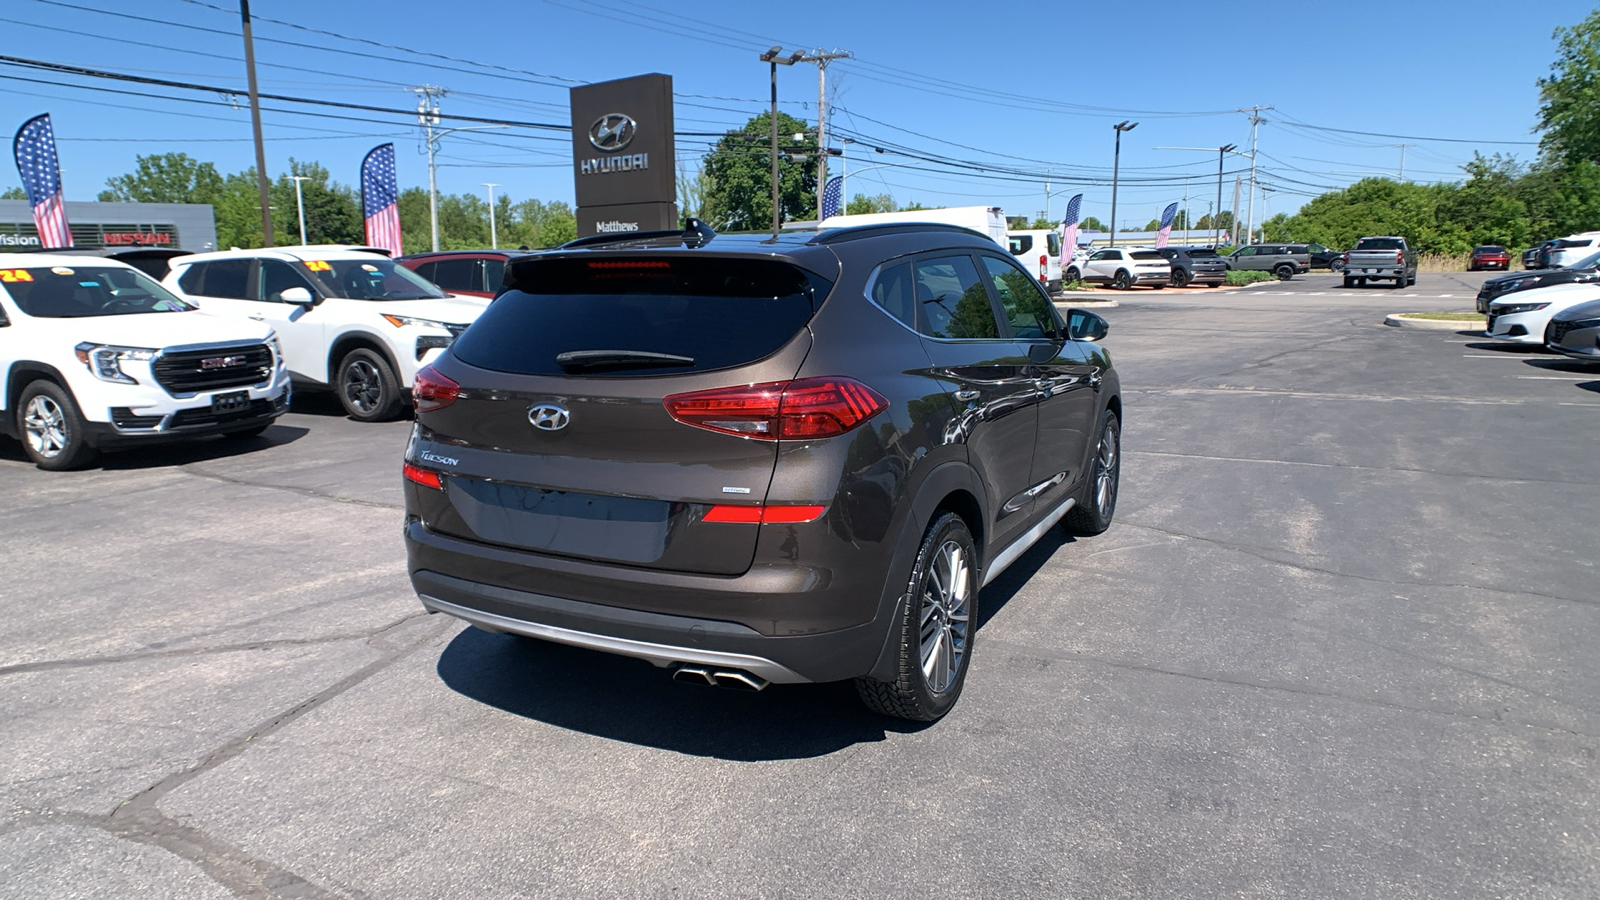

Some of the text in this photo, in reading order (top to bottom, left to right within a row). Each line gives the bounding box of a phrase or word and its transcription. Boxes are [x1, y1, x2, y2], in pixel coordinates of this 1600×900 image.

[581, 153, 649, 175] HYUNDAI
[596, 220, 639, 233] Matthews
[103, 232, 170, 244] NISSAN
[305, 260, 331, 271] 24
[0, 269, 31, 282] 24
